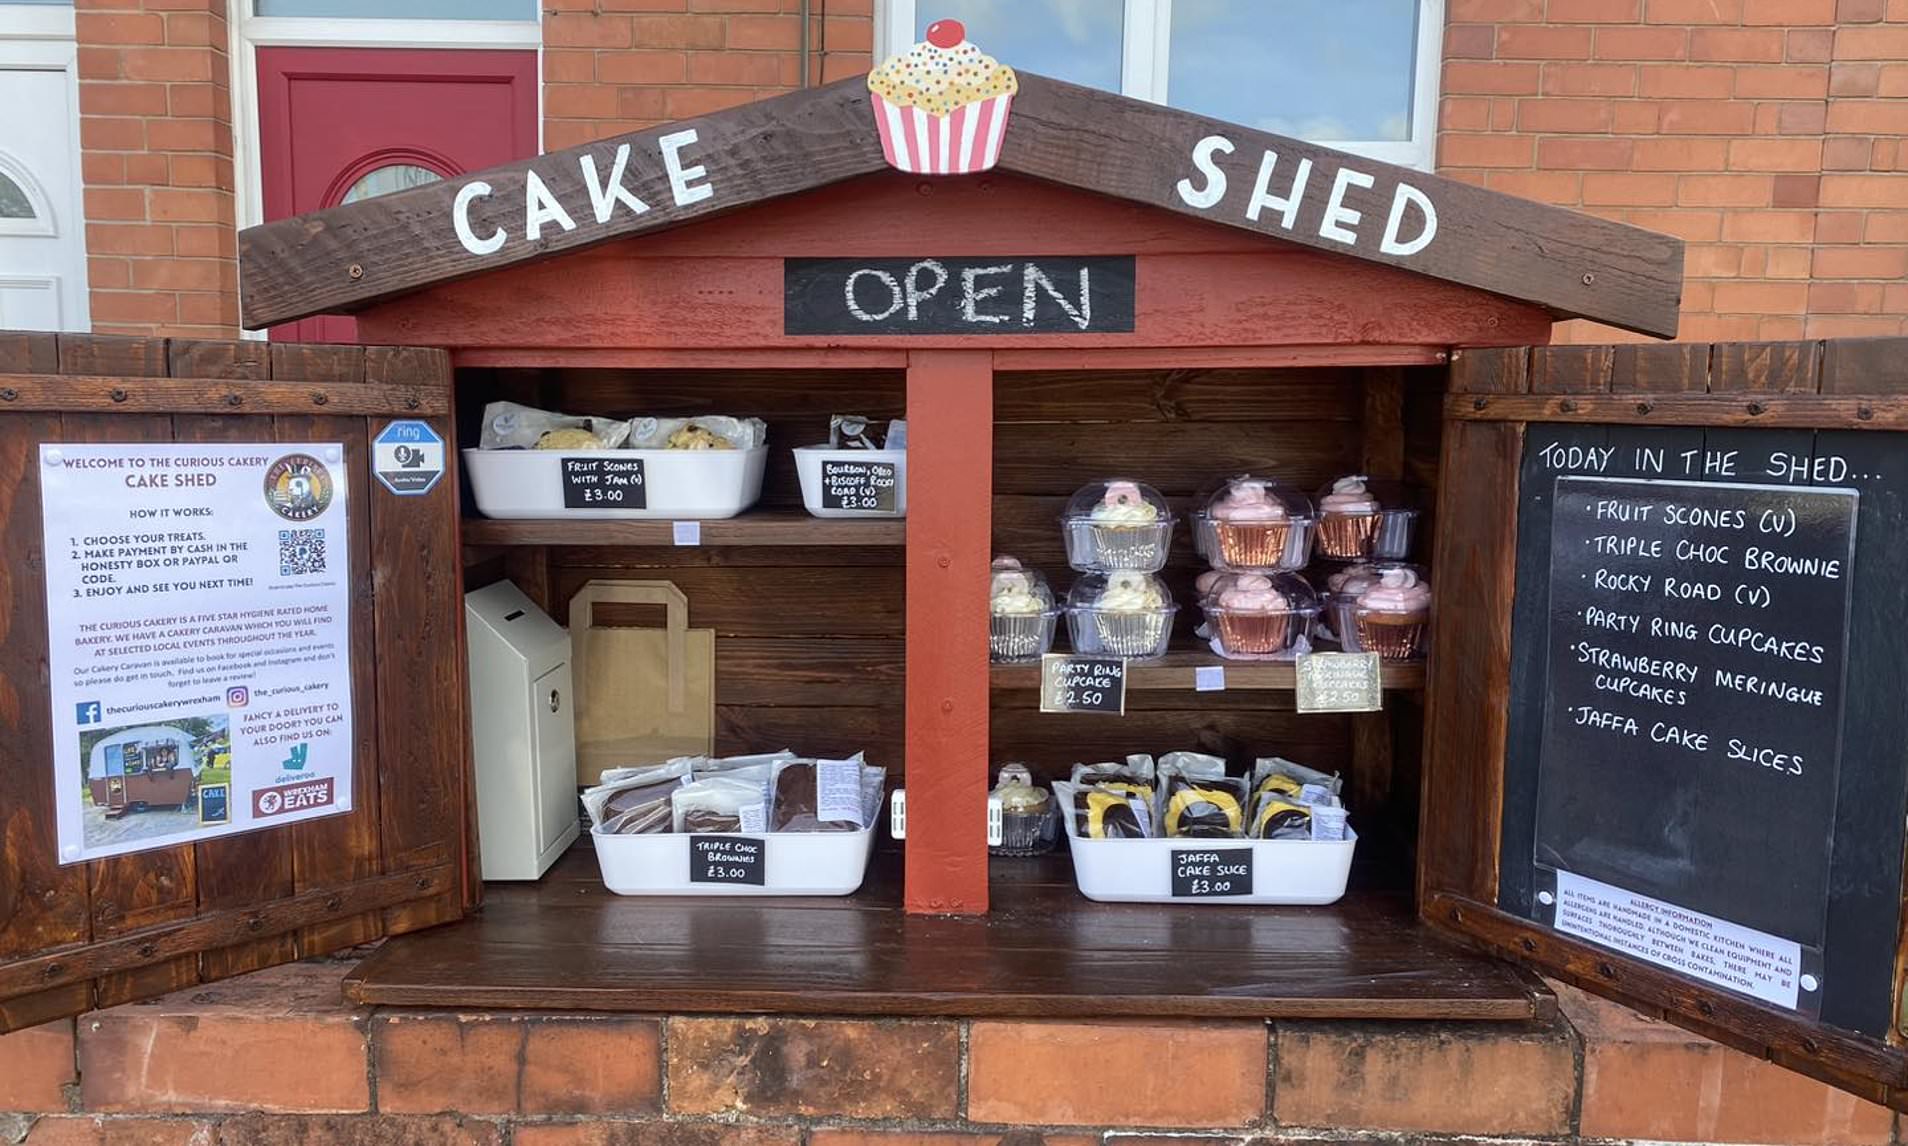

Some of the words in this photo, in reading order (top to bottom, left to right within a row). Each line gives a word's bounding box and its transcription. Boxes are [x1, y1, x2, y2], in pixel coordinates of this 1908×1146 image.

[454, 129, 714, 255] CAKE
[1176, 135, 1437, 255] SHED
[845, 259, 1089, 329] OPEN
[397, 426, 419, 440] ring
[63, 458, 125, 468] WELCOME
[128, 458, 144, 467] TO
[148, 458, 172, 467] THE
[174, 457, 224, 467] CURIOUS
[228, 457, 268, 466] CAKERY
[568, 461, 599, 471] FRUIT
[603, 461, 638, 471] SCONES
[1539, 442, 1615, 471] TODAY
[1635, 447, 1664, 473] IN
[1681, 450, 1738, 476] THE
[125, 474, 168, 488] CAKE
[174, 473, 216, 487] SHED
[571, 475, 598, 483] WITH
[605, 474, 628, 485] JAM
[584, 489, 623, 501] £3.00
[841, 496, 877, 508] £3.00
[129, 509, 157, 518] HOW
[160, 509, 169, 517] IT
[171, 507, 213, 517] WORKS:
[1597, 500, 1653, 521] FRUIT
[1664, 505, 1746, 529] SCONES
[1759, 508, 1796, 537] (V)
[70, 537, 78, 546] 1.
[84, 535, 130, 545] CHOOSE
[134, 534, 164, 543] YOUR
[168, 532, 206, 542] TREATS.
[71, 550, 80, 559] 2.
[85, 548, 114, 558] MAKE
[118, 546, 167, 557] PAYMENT
[170, 545, 183, 554] BY
[187, 543, 212, 553] CASH
[216, 543, 228, 551] IN
[231, 542, 247, 551] THE
[1595, 536, 1662, 558] TRIPLE
[1676, 540, 1729, 564] CHOC
[1745, 548, 1840, 579] BROWNIE
[81, 560, 132, 571] HONESTY
[136, 559, 159, 568] BOX
[163, 557, 179, 567] OR
[182, 555, 218, 565] PAYPAL
[222, 554, 238, 563] OR
[82, 573, 115, 584] CODE.
[73, 588, 82, 598] 3.
[86, 586, 122, 597] ENJOY
[126, 584, 149, 594] AND
[153, 583, 169, 592] SEE
[173, 581, 196, 591] YOU
[200, 579, 224, 589] NEXT
[228, 577, 252, 587] TIME!
[1595, 569, 1651, 593] ROCKY
[1664, 578, 1721, 601] ROAD
[1735, 584, 1770, 609] (V)
[79, 623, 96, 632] THE
[99, 619, 141, 631] CURIOUS
[143, 616, 176, 627] CAKERY
[179, 616, 187, 624] IS
[189, 615, 195, 623] A
[197, 613, 215, 622] FIVE
[217, 611, 238, 621] STAR
[240, 609, 273, 619] HYGIENE
[276, 606, 301, 616] RATED
[303, 604, 327, 613] HOME
[75, 634, 112, 645] BAKERY.
[115, 633, 128, 642] WE
[130, 631, 153, 640] HAVE
[156, 630, 164, 638] A
[167, 627, 200, 637] CAKERY
[203, 623, 242, 634] CARAVAN
[244, 620, 272, 630] WHICH
[275, 619, 291, 627] YOU
[293, 617, 312, 626] WILL
[314, 615, 331, 624] FIND
[1585, 606, 1640, 633] PARTY
[1651, 618, 1698, 640] RING
[1708, 624, 1824, 664] CUPCAKES
[94, 648, 106, 657] AT
[108, 644, 151, 656] SELECTED
[153, 641, 180, 651] LOCAL
[183, 638, 215, 648] EVENTS
[218, 632, 275, 645] THROUGHOUT
[277, 631, 292, 639] THE
[294, 629, 315, 638] YEAR.
[1052, 662, 1089, 673] PARTY
[1094, 665, 1121, 677] RING
[1578, 642, 1698, 683] STRAWBERRY
[1716, 670, 1823, 706] MERINGUE
[1054, 676, 1111, 688] CUPCAKE
[1595, 675, 1687, 706] CUPCAKES
[106, 693, 220, 716] thecuriouscakerywrexham
[1055, 691, 1102, 704] £2.50
[243, 711, 272, 722] FANCY
[274, 709, 281, 718] A
[283, 704, 323, 716] DELIVERY
[327, 702, 339, 710] TO
[240, 724, 266, 735] YOUR
[304, 716, 322, 726] YOU
[325, 714, 342, 723] CAN
[253, 735, 276, 746] ALSO
[280, 732, 299, 742] FIND
[302, 730, 313, 739] US
[1575, 706, 1639, 736] JAFFA
[1650, 722, 1709, 751] CAKE
[1728, 739, 1803, 775] SLICES
[283, 782, 327, 796] WREXHAM
[283, 790, 327, 809] EATS
[696, 842, 731, 851] TRIPLE
[735, 843, 758, 853] CHOC
[708, 852, 754, 863] BROWNIES
[1178, 854, 1219, 864] JAFFA
[708, 866, 745, 878] £3.00
[1178, 866, 1211, 877] CAKE
[1192, 879, 1230, 894] £3.00
[1630, 897, 1658, 912] ALLERGY
[1660, 907, 1712, 929] INFORMATION
